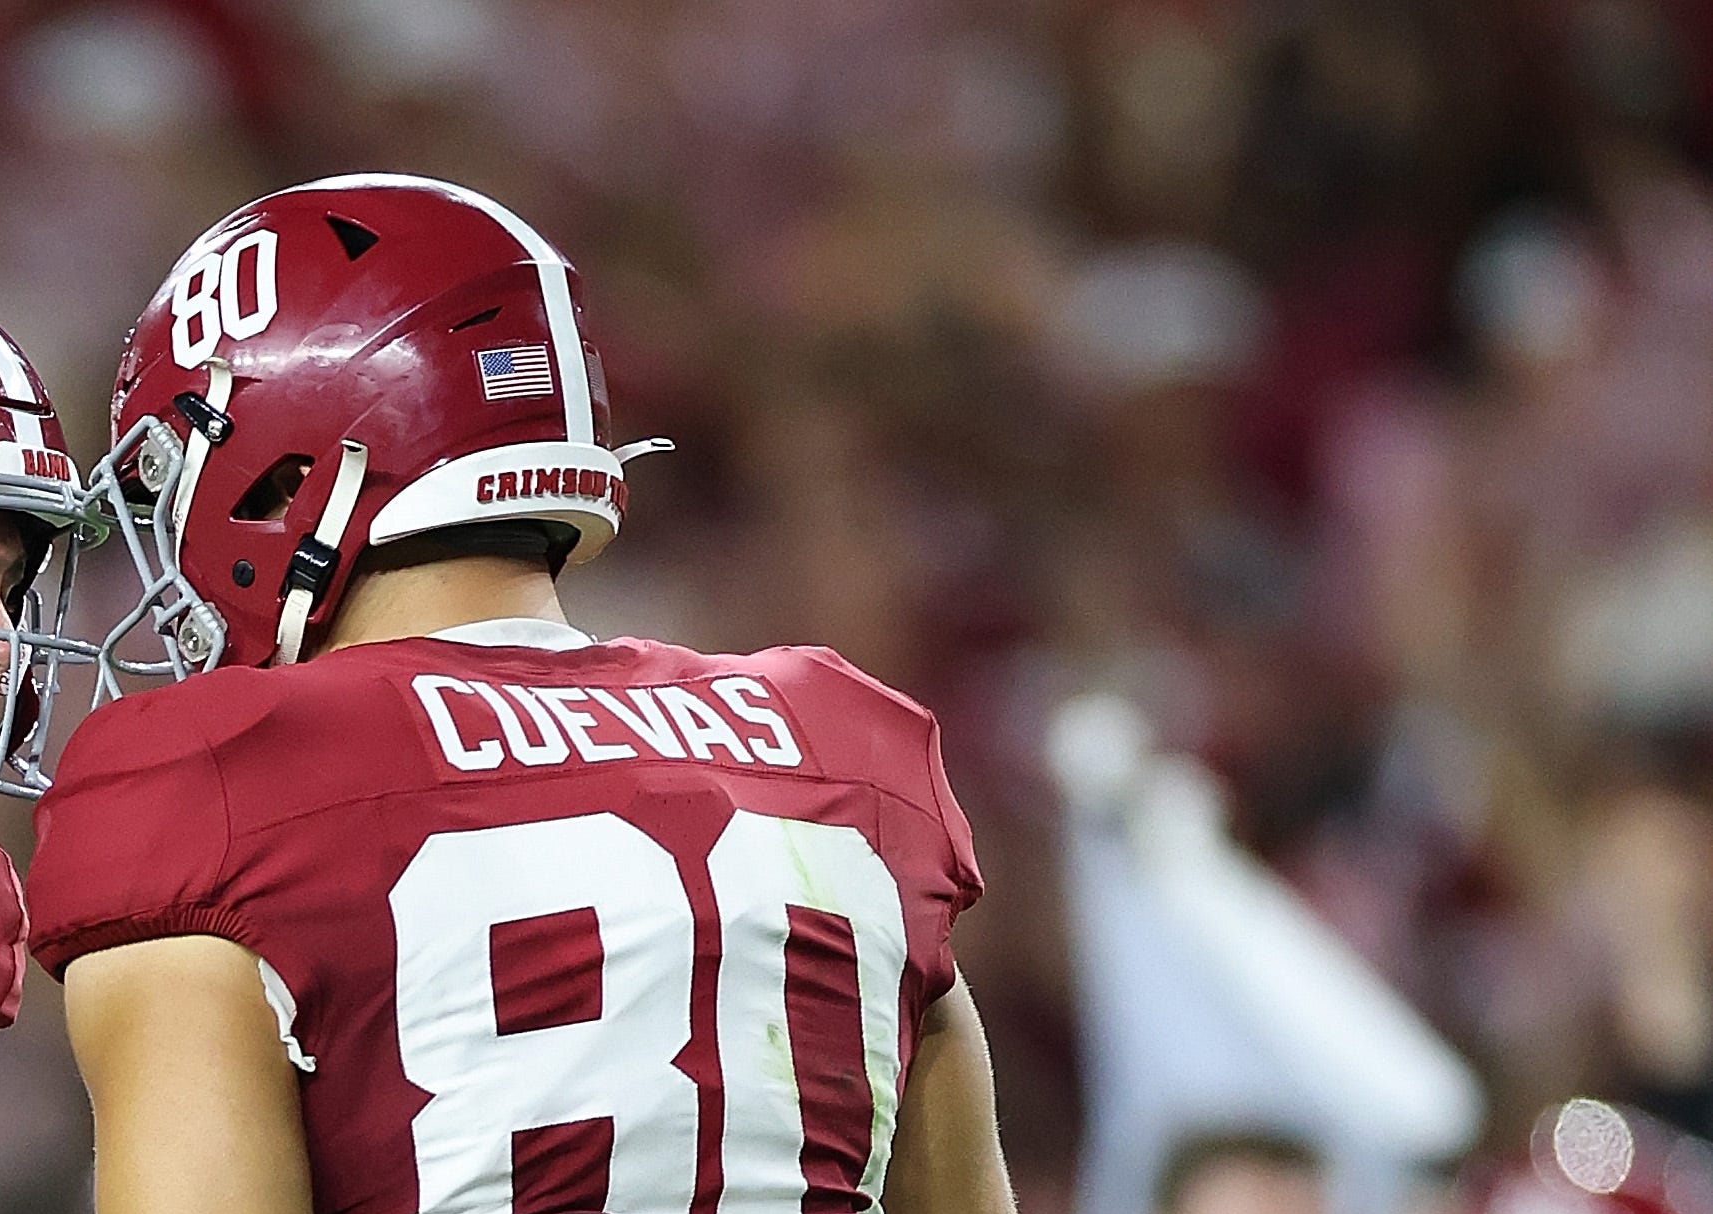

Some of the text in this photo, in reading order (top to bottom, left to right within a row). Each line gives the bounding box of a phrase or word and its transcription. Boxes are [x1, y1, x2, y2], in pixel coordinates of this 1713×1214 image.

[171, 228, 278, 371] 80
[476, 467, 608, 504] CRIMSON
[411, 673, 804, 772] CUEVAS
